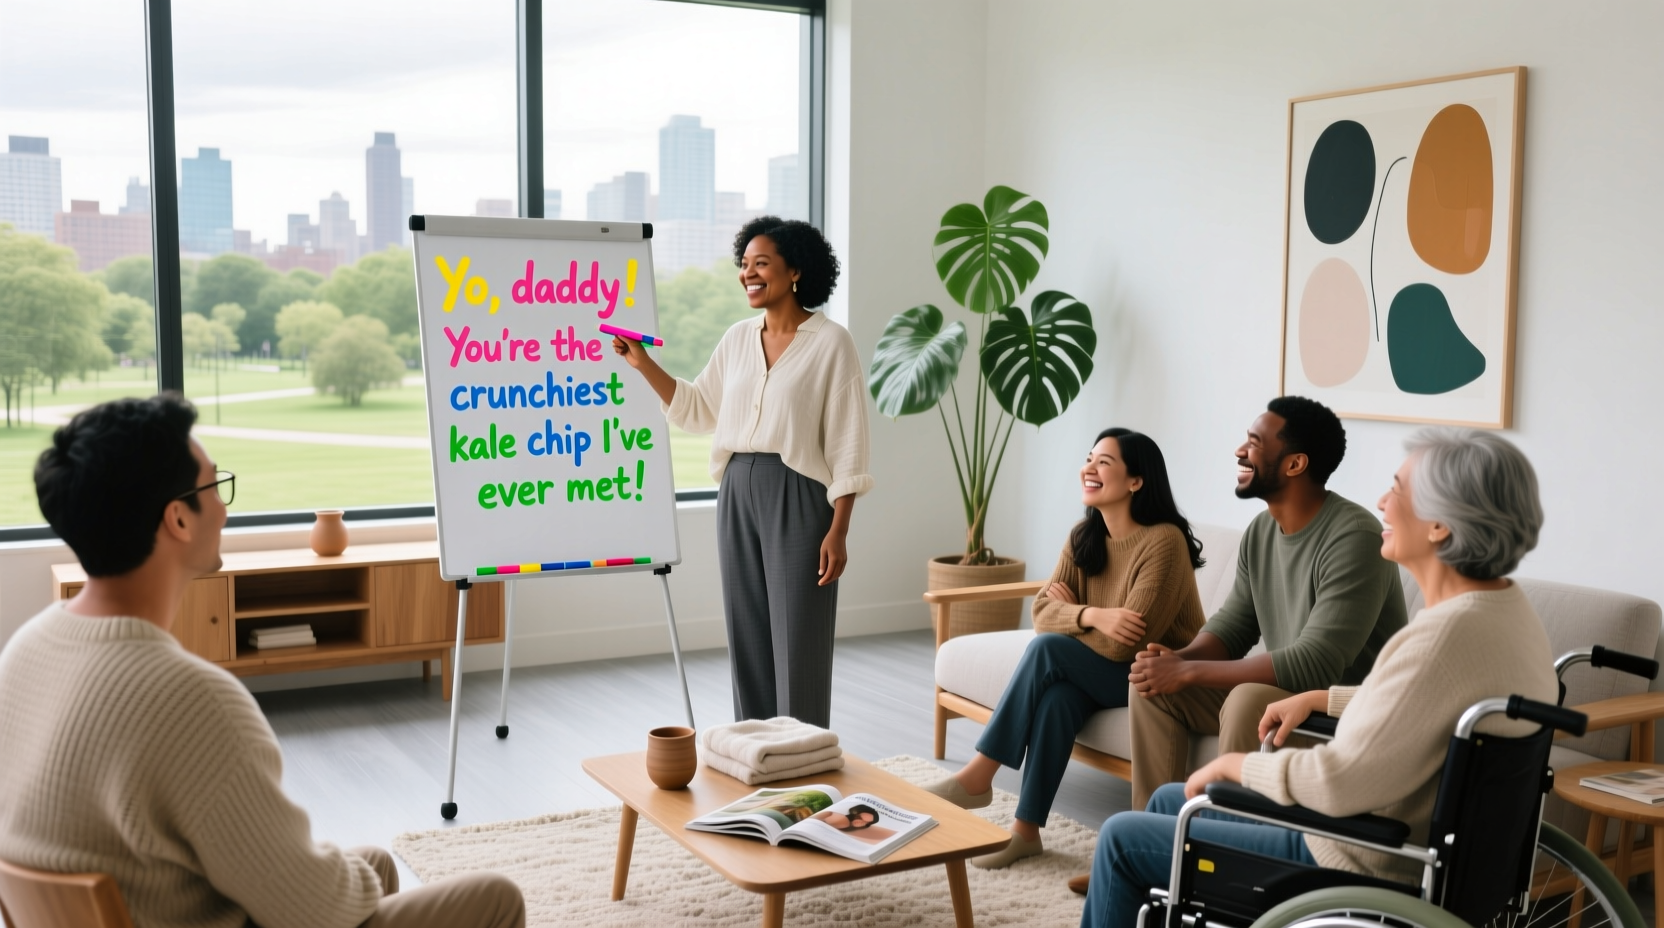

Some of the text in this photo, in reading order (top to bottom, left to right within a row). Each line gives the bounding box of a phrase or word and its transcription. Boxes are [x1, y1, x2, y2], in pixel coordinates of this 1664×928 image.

[435, 256, 638, 319] Yo, daddy!
[444, 326, 603, 367] You're the
[450, 371, 624, 411] crunchiest
[450, 417, 653, 467] kale chip I've
[478, 460, 645, 509] ever met!
